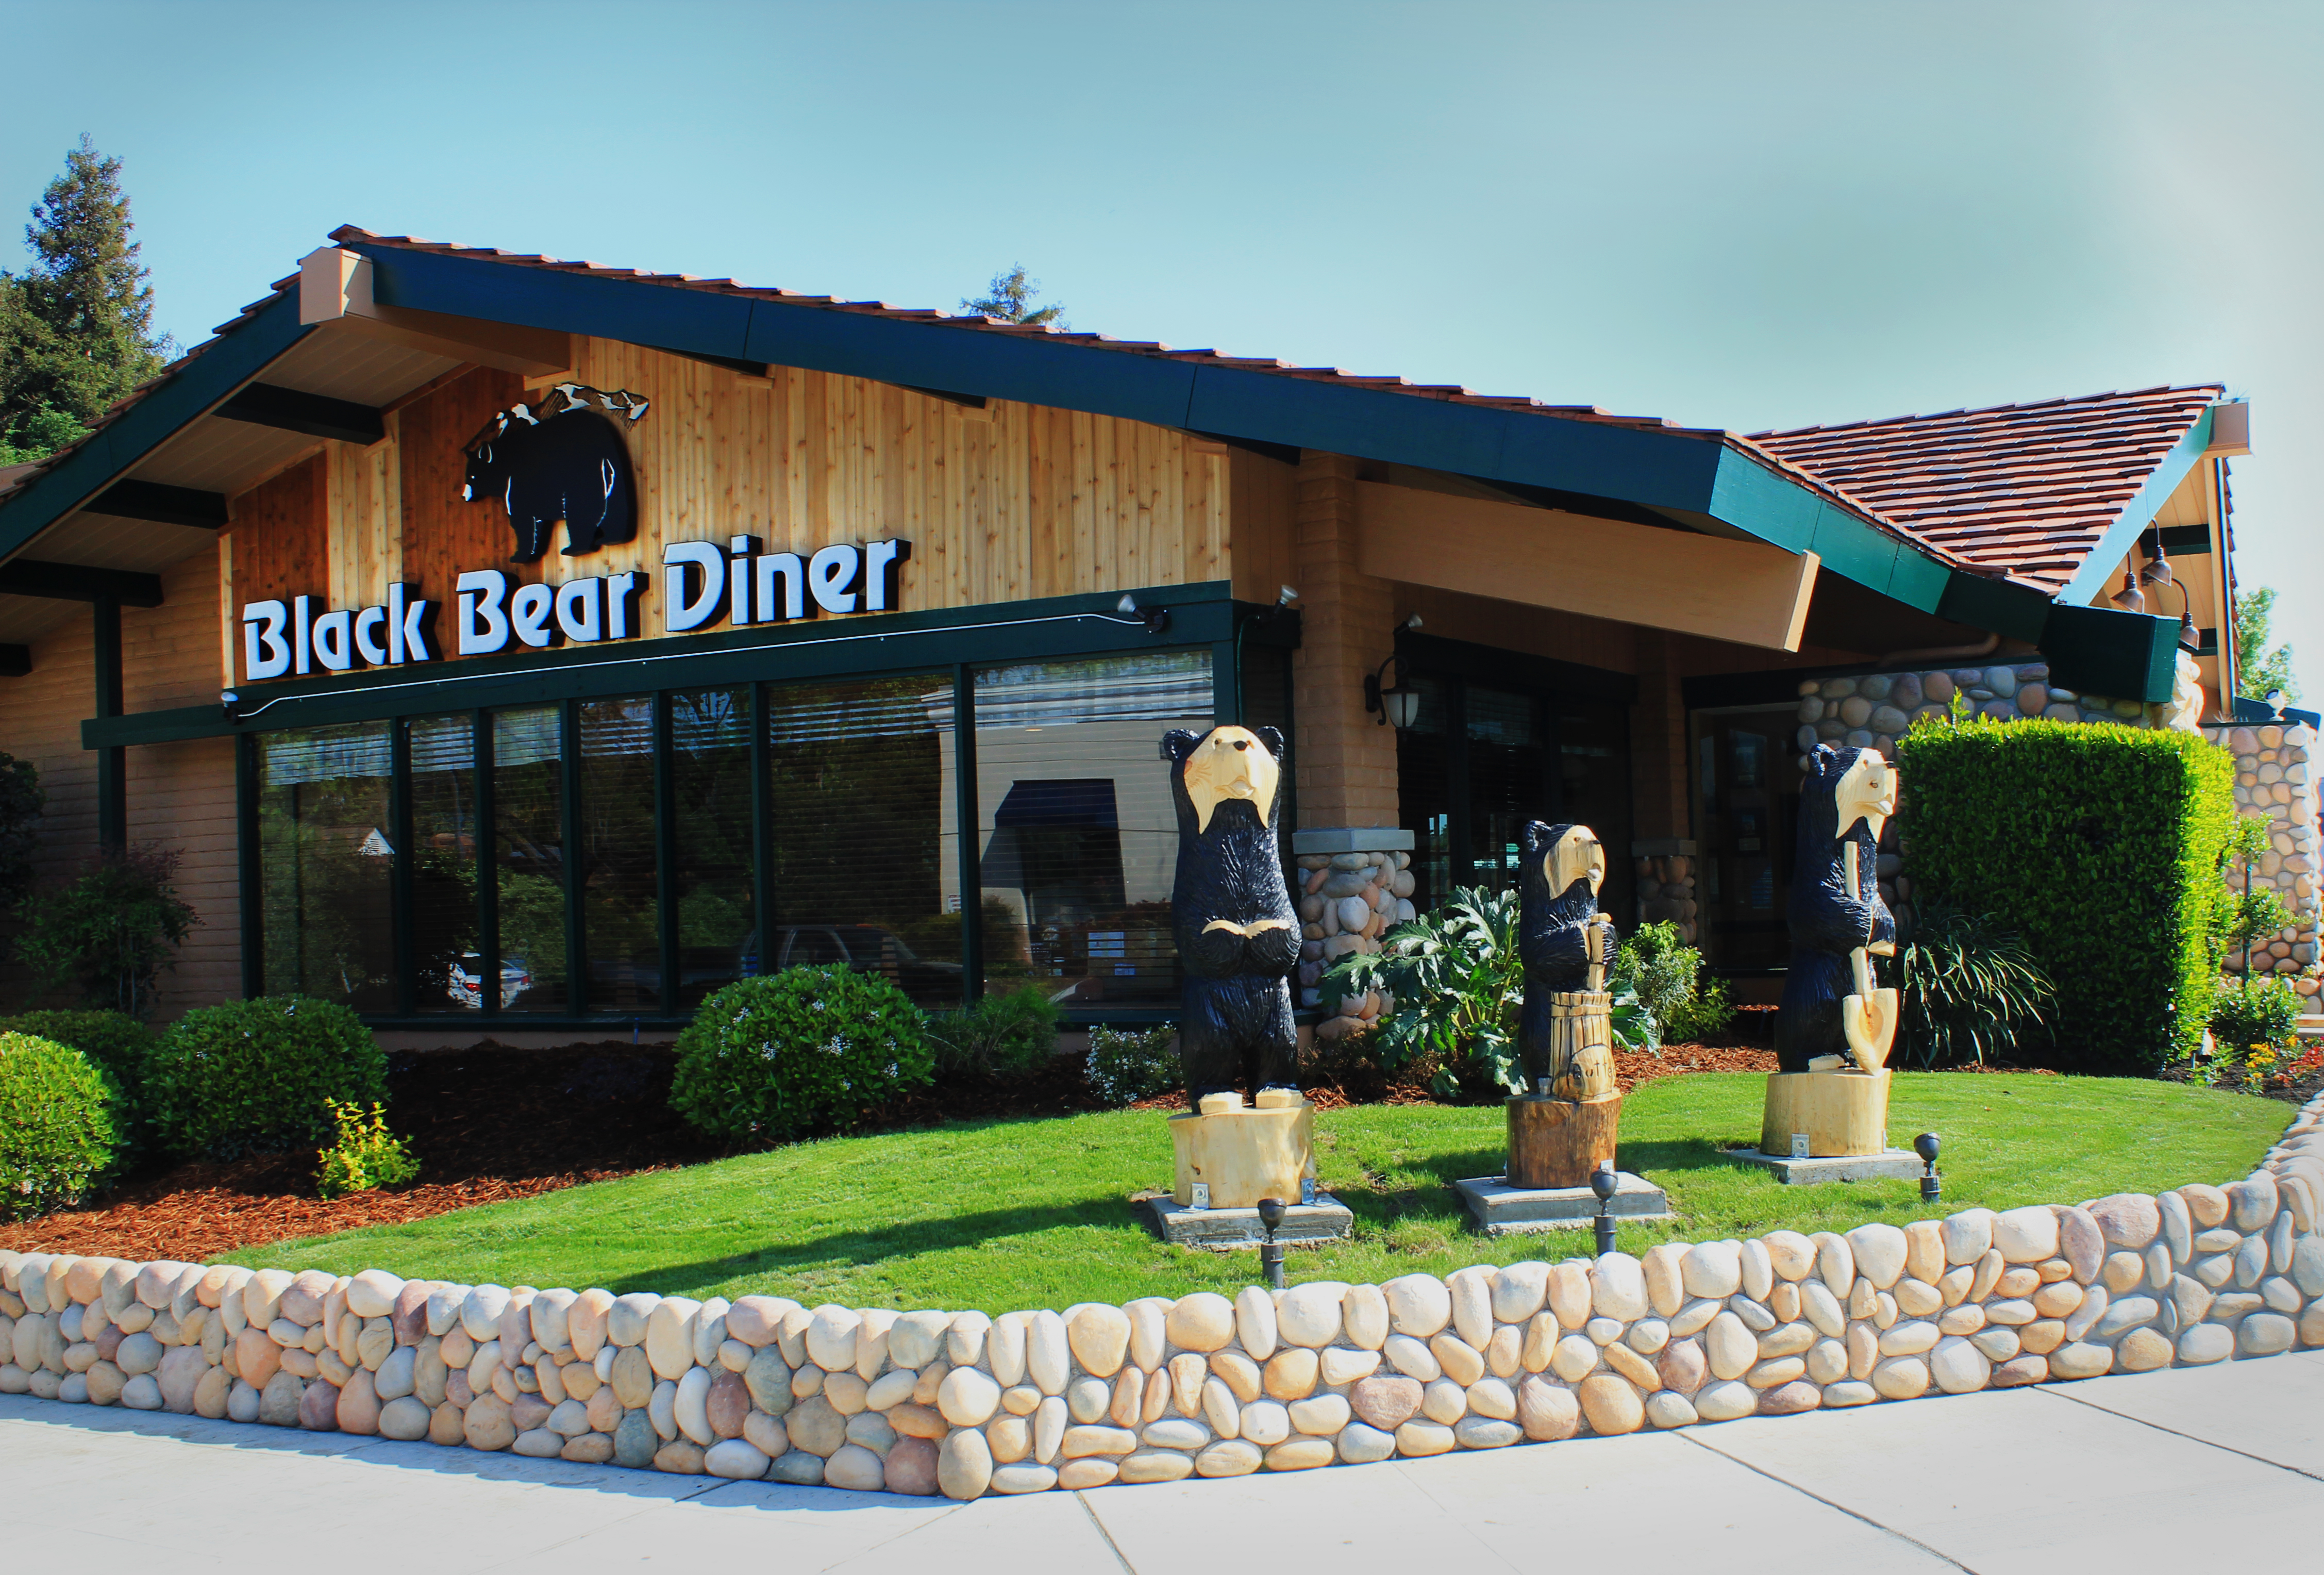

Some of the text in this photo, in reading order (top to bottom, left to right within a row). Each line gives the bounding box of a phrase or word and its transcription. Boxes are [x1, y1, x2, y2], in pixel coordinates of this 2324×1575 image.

[243, 534, 901, 681] Black Bear Diner
